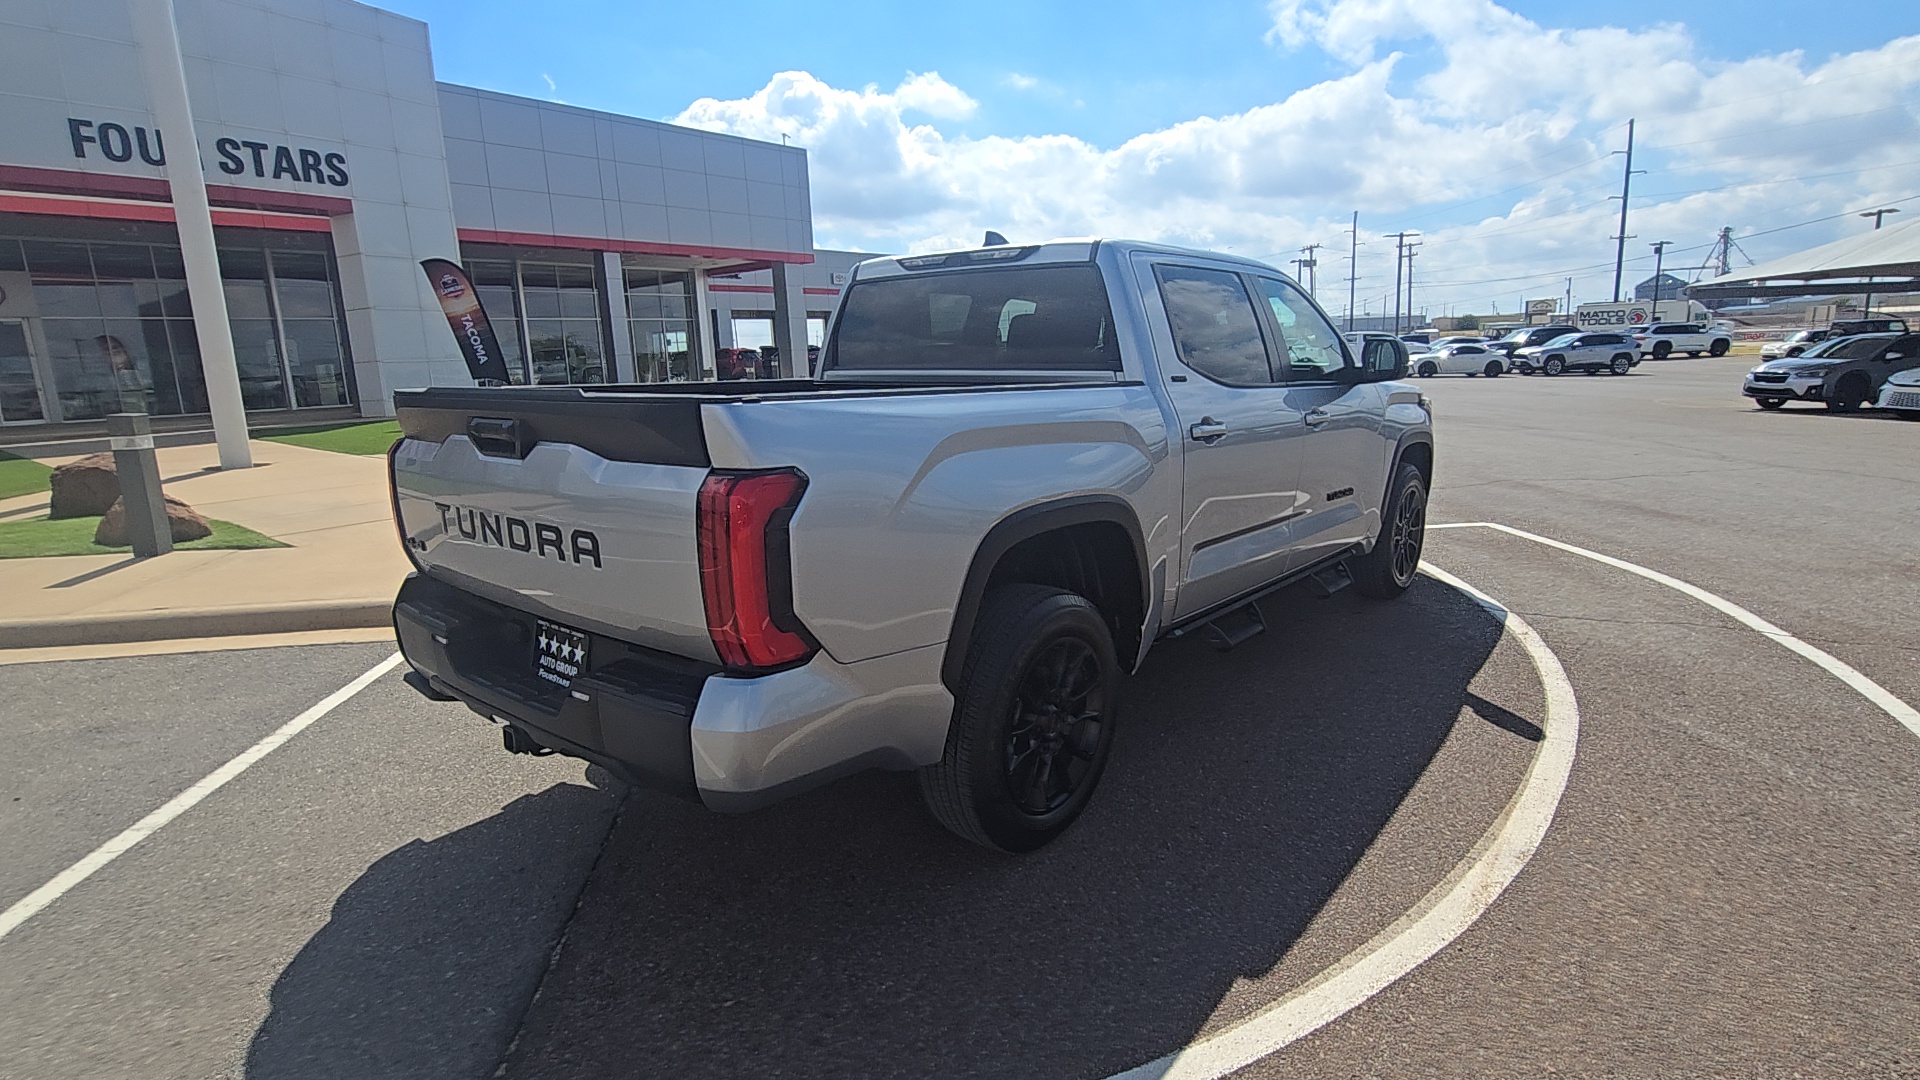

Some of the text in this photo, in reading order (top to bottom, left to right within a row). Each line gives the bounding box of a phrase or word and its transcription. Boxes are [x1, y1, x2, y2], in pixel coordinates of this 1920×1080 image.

[67, 118, 349, 187] FOU STARS
[1579, 309, 1626, 319] MATCO
[1579, 317, 1626, 326] TOOLS
[461, 313, 489, 365] TACOMA
[435, 501, 602, 569] TUNDRA
[540, 655, 578, 677] AUTO GROUP
